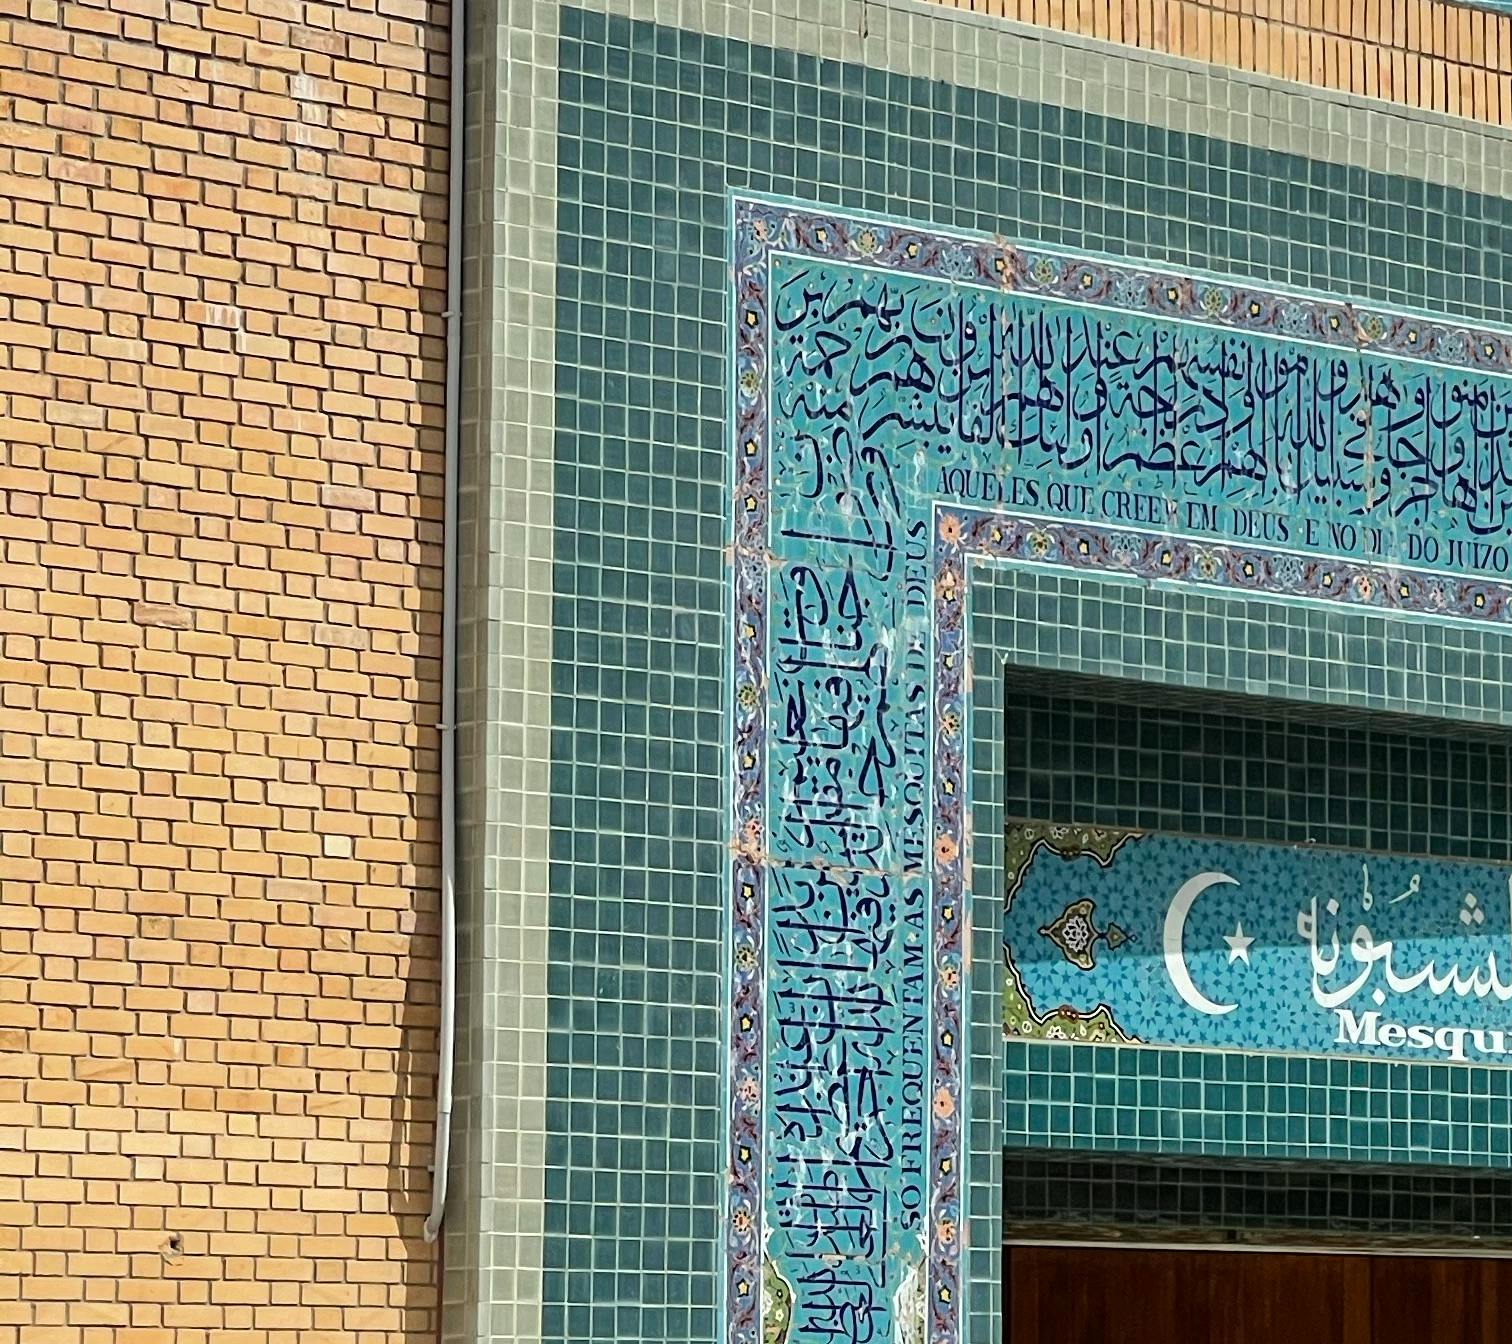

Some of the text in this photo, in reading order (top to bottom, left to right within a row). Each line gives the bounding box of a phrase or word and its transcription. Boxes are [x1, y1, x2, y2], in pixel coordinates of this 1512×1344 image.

[905, 519, 929, 607] DEUS
[1047, 482, 1094, 515] QUE
[1186, 501, 1218, 531] EM
[1233, 507, 1289, 543] DEUS
[1305, 518, 1320, 546] E
[1327, 521, 1357, 551] NO
[1407, 532, 1440, 563] DO
[903, 887, 925, 931] AS
[901, 943, 925, 1177] FREQUENTAM
